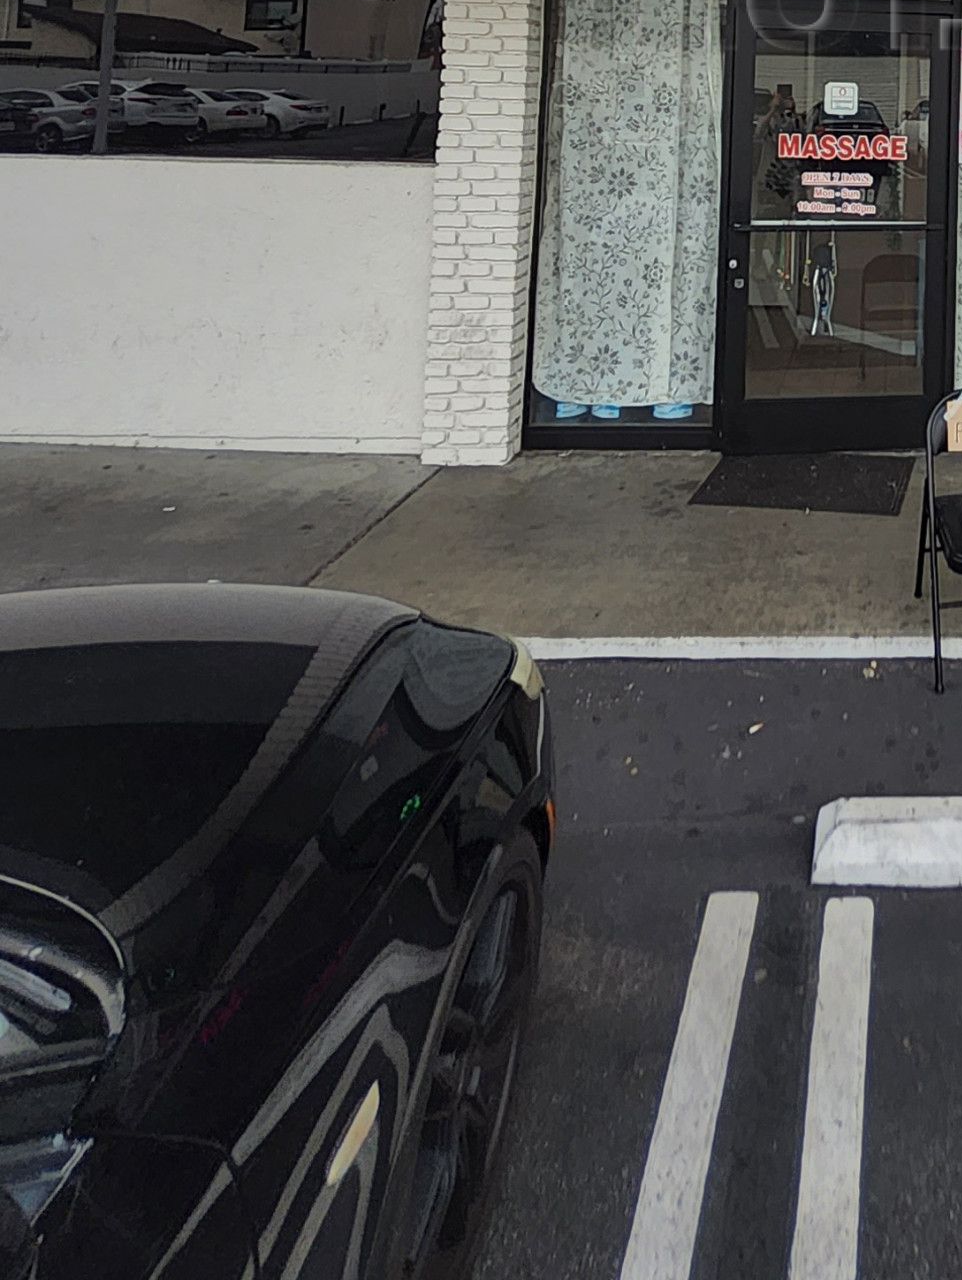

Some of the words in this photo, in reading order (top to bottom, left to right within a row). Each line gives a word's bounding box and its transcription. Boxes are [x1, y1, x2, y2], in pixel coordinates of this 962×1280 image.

[779, 133, 907, 160] MASSAGE
[802, 173, 831, 183] OPEN
[814, 188, 835, 198] Mon
[841, 188, 860, 199] Sun
